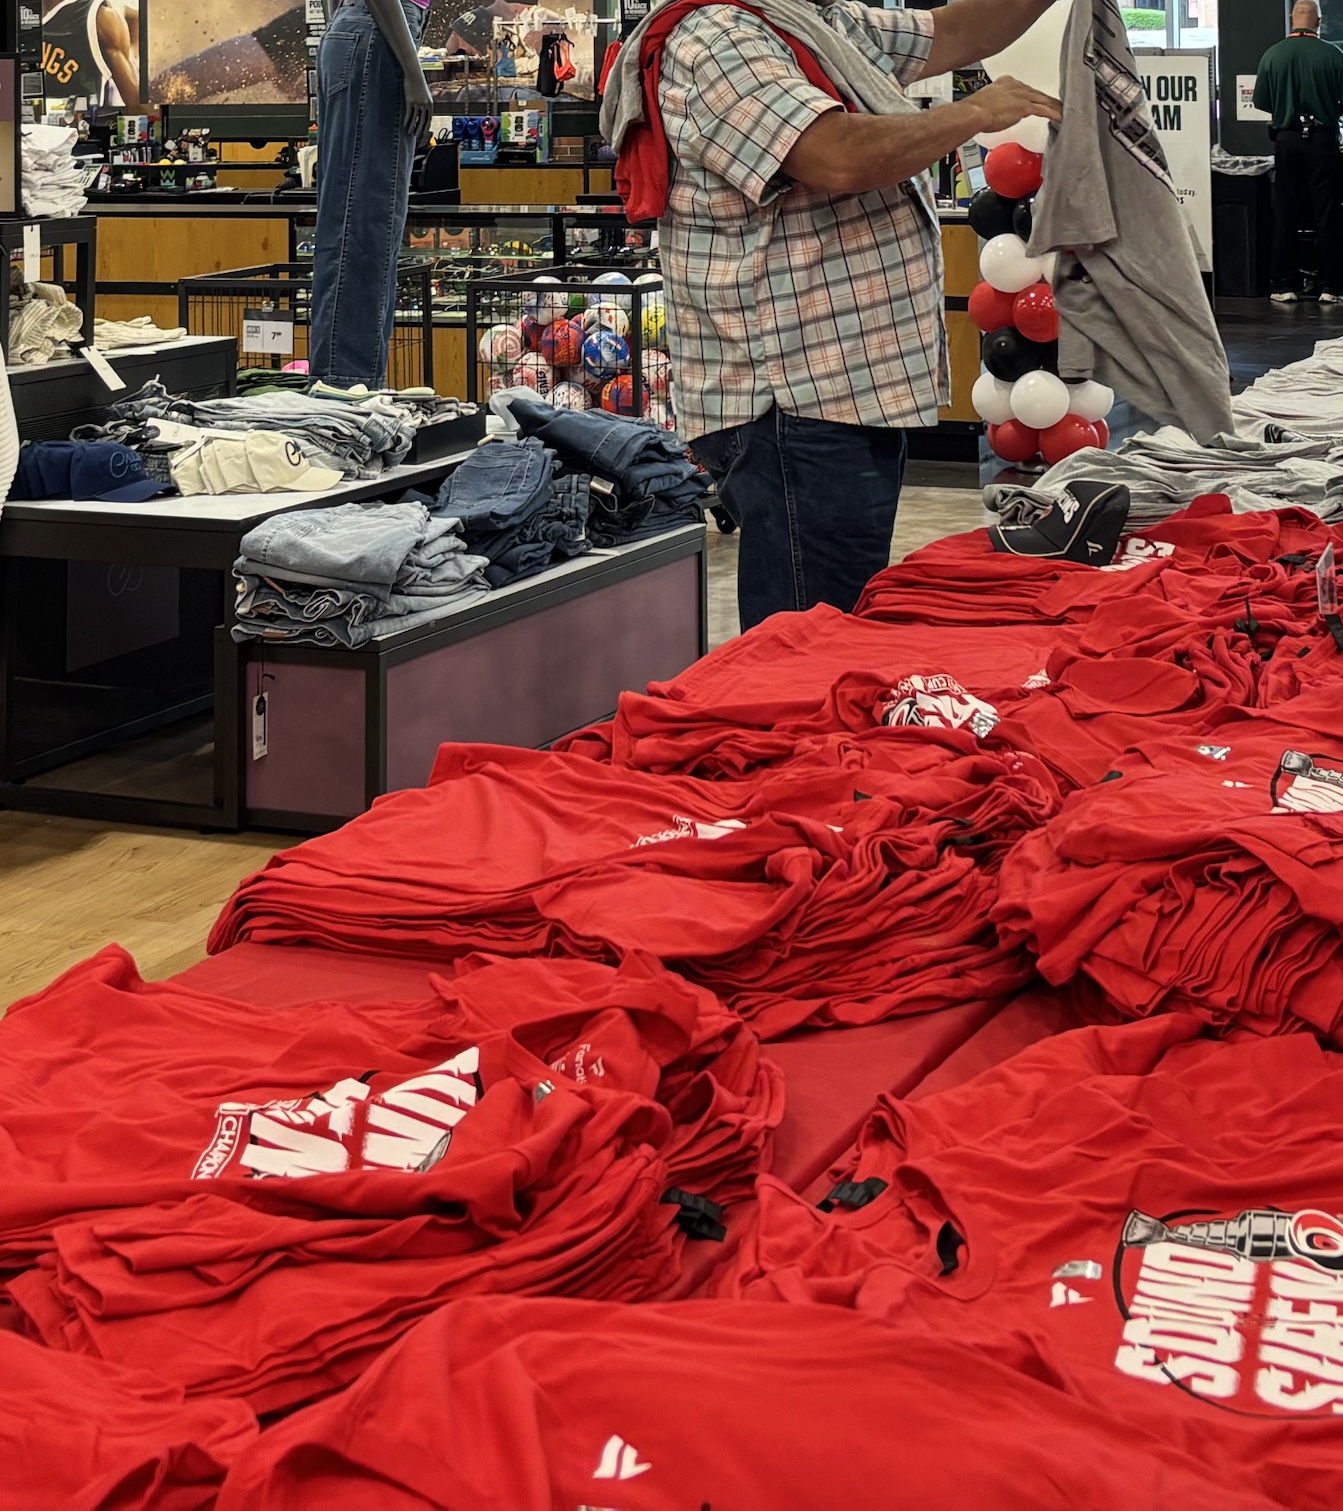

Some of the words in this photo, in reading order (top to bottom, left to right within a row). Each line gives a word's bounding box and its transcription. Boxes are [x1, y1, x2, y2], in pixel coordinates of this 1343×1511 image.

[1156, 75, 1198, 102] OUR
[1151, 104, 1182, 131] AM
[927, 676, 947, 690] CUP
[1114, 1241, 1260, 1398] SOUND
